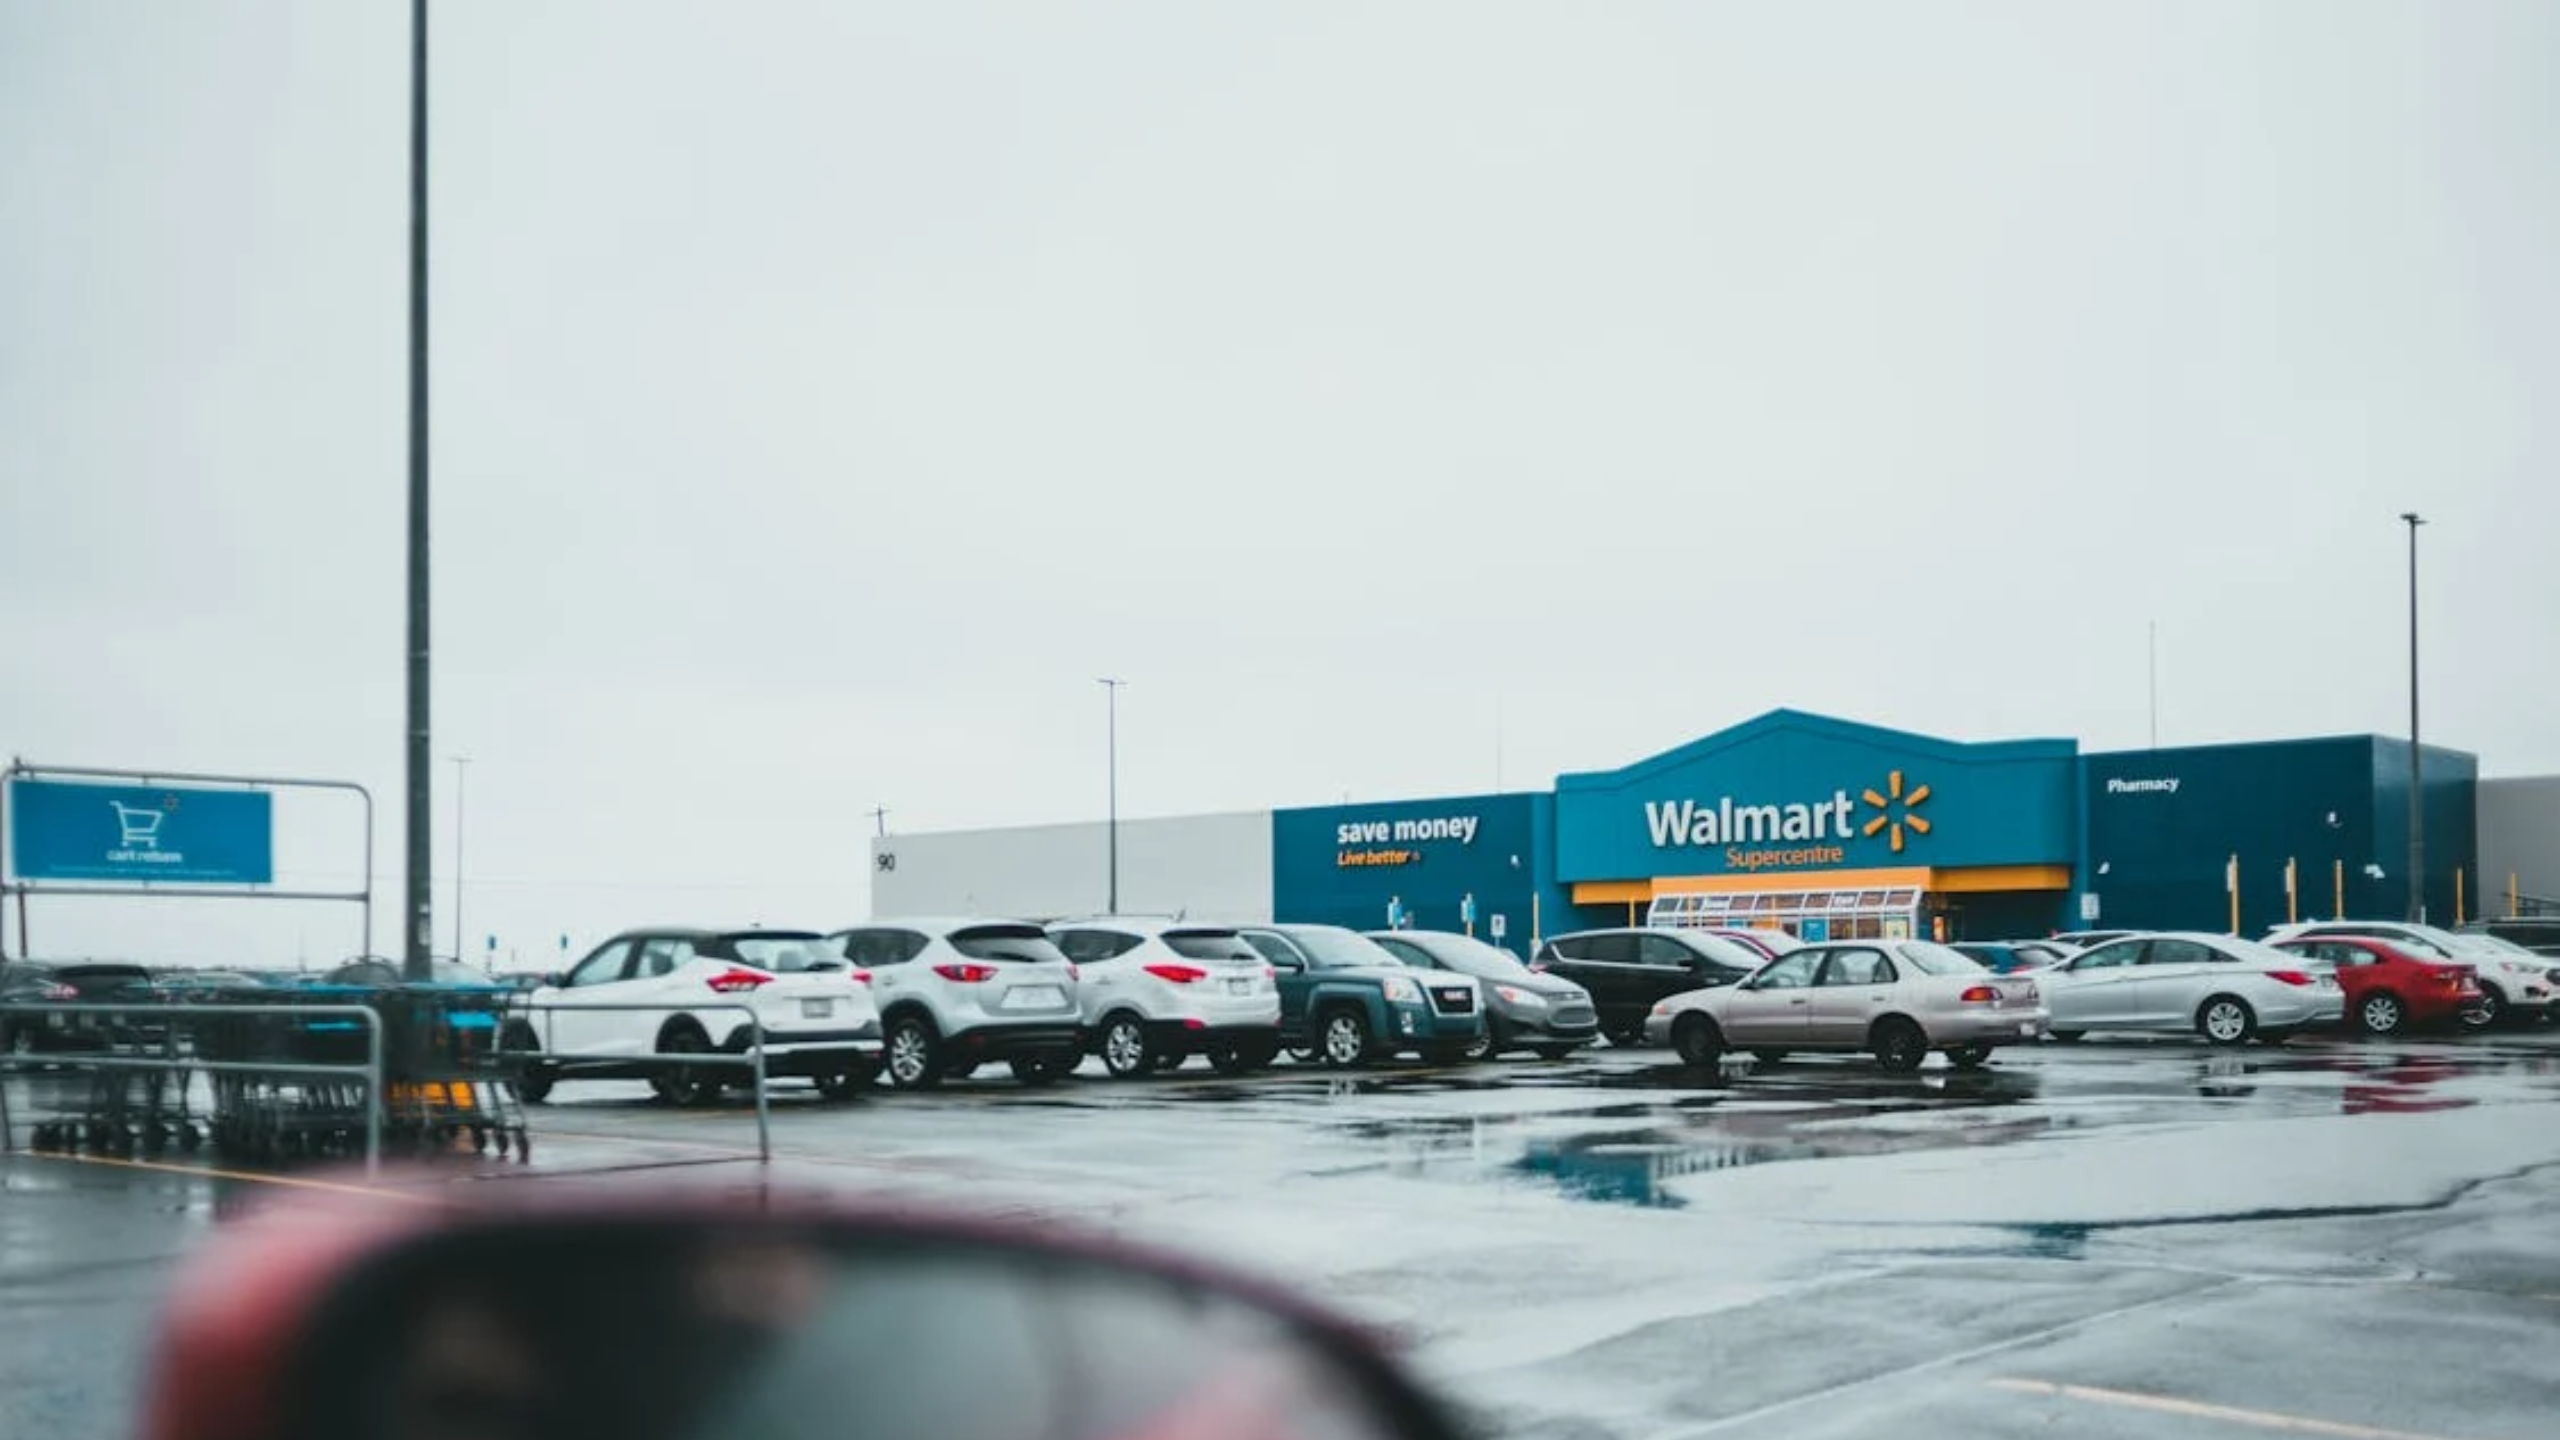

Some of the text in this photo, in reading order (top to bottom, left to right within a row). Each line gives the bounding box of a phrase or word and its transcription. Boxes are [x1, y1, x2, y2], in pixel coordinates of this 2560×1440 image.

[2107, 778, 2180, 793] Pharmacy
[1645, 790, 1853, 846] Walmart
[1337, 815, 1478, 844] save money
[878, 853, 895, 871] 90
[1337, 849, 1410, 866] Live better
[1726, 845, 1843, 872] Supercentre
